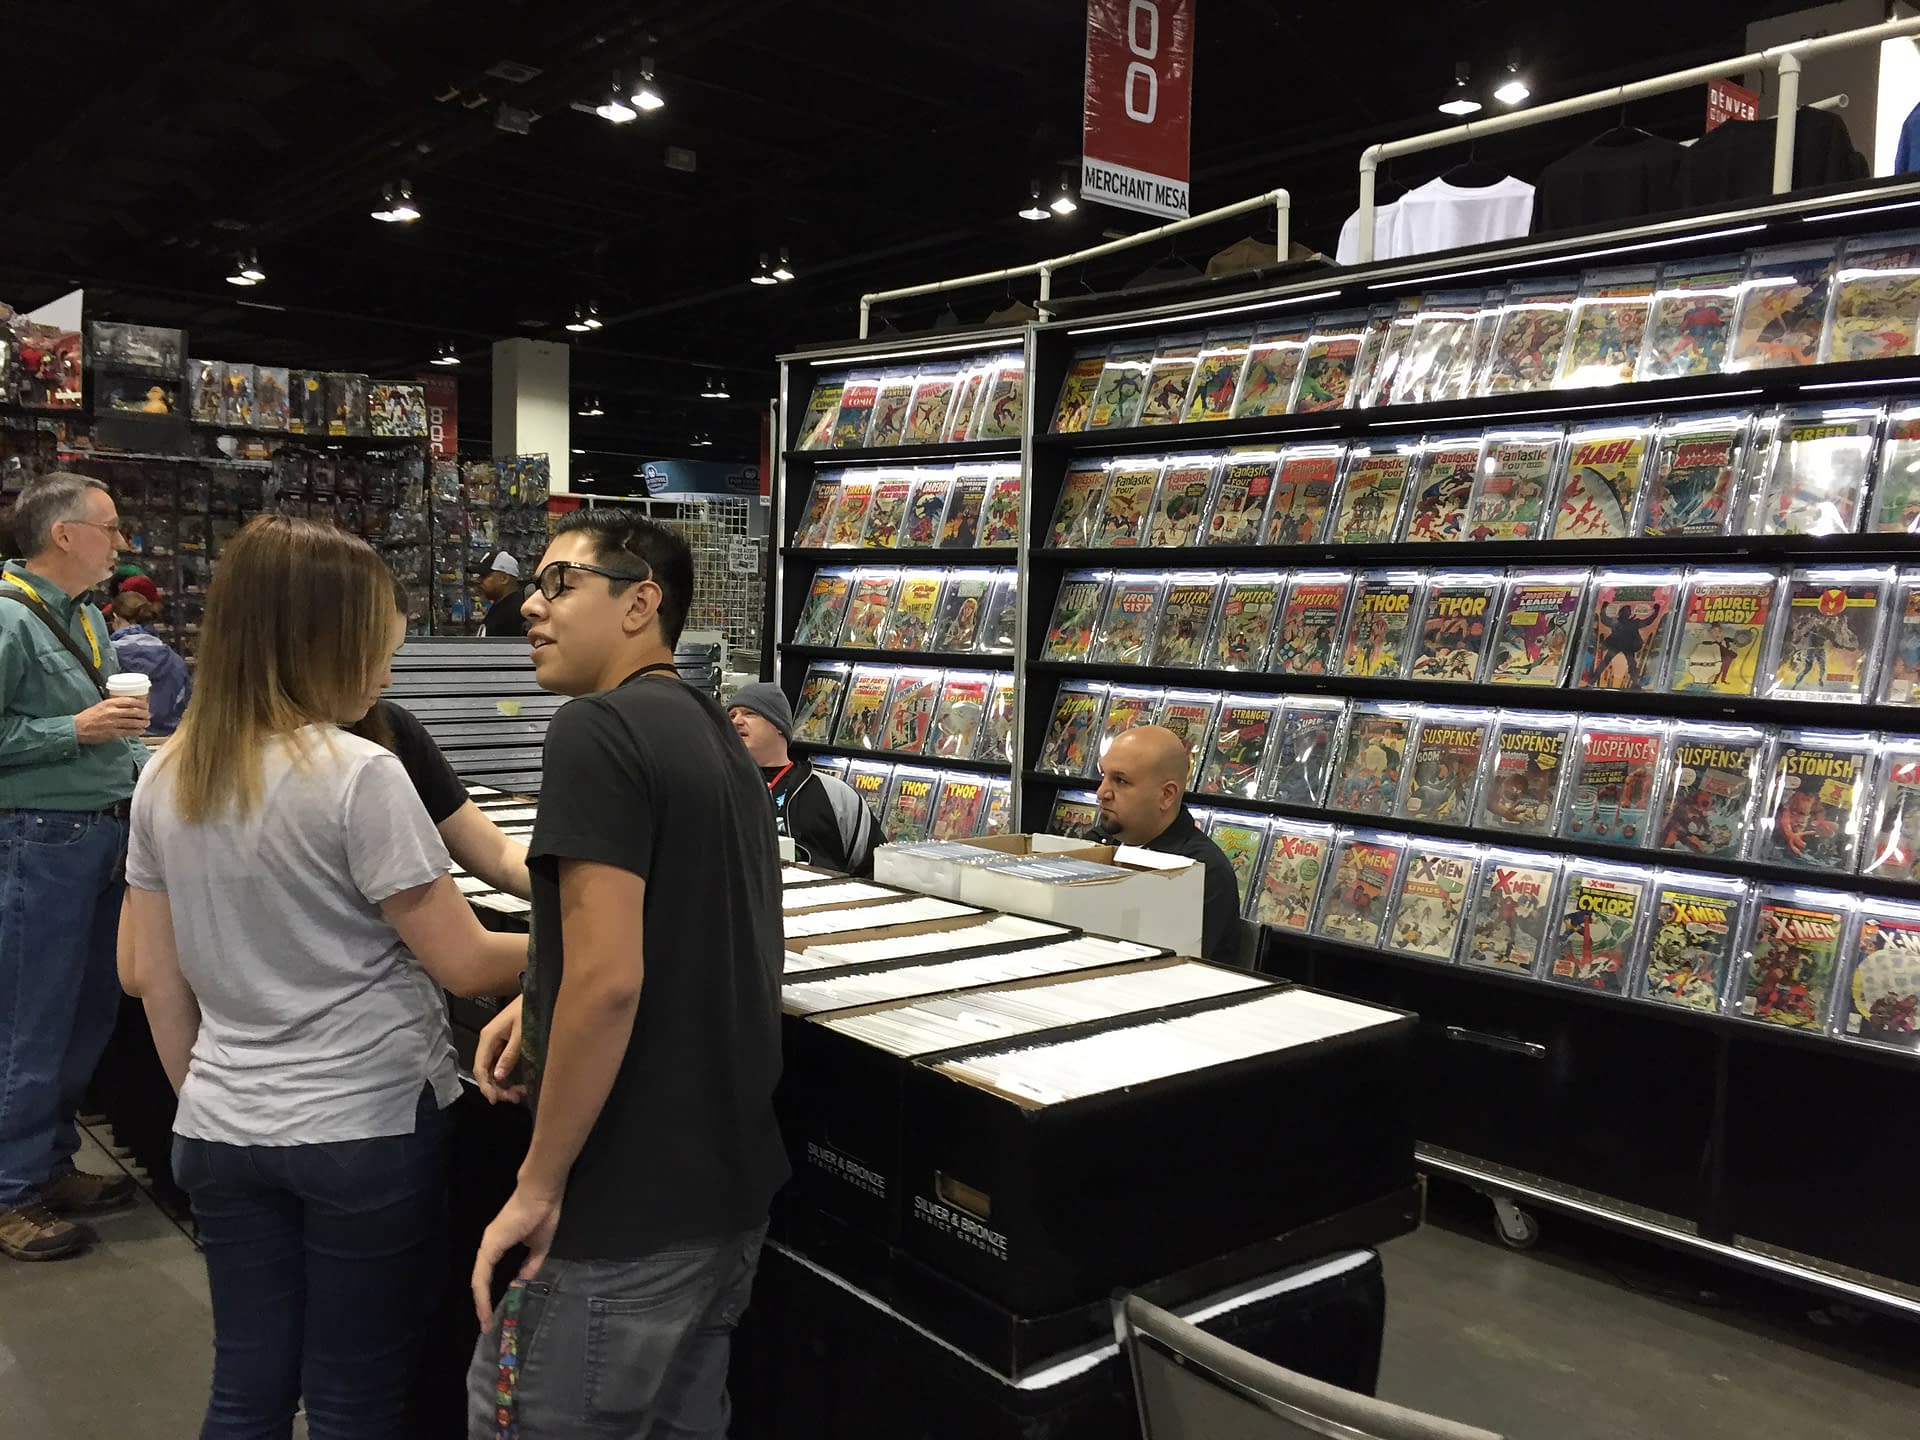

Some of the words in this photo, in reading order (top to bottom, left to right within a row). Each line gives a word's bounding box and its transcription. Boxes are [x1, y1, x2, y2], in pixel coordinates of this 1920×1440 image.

[1710, 88, 1755, 121] DENVER
[1085, 165, 1154, 202] MERCHANT
[1155, 184, 1188, 211] MESA
[1790, 425, 1849, 442] GREEN
[1573, 438, 1636, 466] FLASH
[1123, 593, 1154, 603] IRON
[1168, 591, 1212, 604] MYSTERY
[1234, 591, 1276, 602] MYSTERY
[1295, 593, 1340, 605] MYSTERY
[1362, 594, 1409, 613] THOR
[1519, 598, 1563, 606] LEAGUE
[1704, 597, 1760, 611] LAUREL
[1122, 603, 1152, 612] FIST
[1439, 597, 1487, 617] THOR
[1704, 609, 1756, 624] HARDY
[1171, 706, 1206, 718] STRANGE
[1232, 708, 1267, 720] STRANGE
[1421, 729, 1478, 747] SUSPENSE
[1500, 733, 1558, 753] SUSPENSE
[1584, 739, 1649, 760] SUSPENSE
[1674, 746, 1746, 769] SUSPENSE
[1777, 755, 1855, 778] ASTONISH
[855, 774, 883, 791] THOR
[901, 780, 931, 797] THOR
[950, 783, 977, 799] THOR
[1276, 835, 1319, 860] X-MEN
[1348, 846, 1390, 869] X-MEN
[1415, 854, 1464, 882] X-MEN
[1491, 868, 1542, 897] X-MEN
[1589, 879, 1616, 889] X-MEN
[1578, 894, 1635, 917] CYCLOPS
[1672, 901, 1729, 925] X-MEN
[1771, 916, 1837, 942] X-MEN
[807, 1141, 838, 1166] SILVER
[838, 1155, 845, 1172] &
[846, 1160, 887, 1190] BRONZE
[914, 1195, 950, 1223] SILVER
[950, 1212, 960, 1228] &
[960, 1217, 1008, 1251] BRONZE
[913, 1210, 952, 1233] STRICT
[956, 1230, 1008, 1262] GRADING
